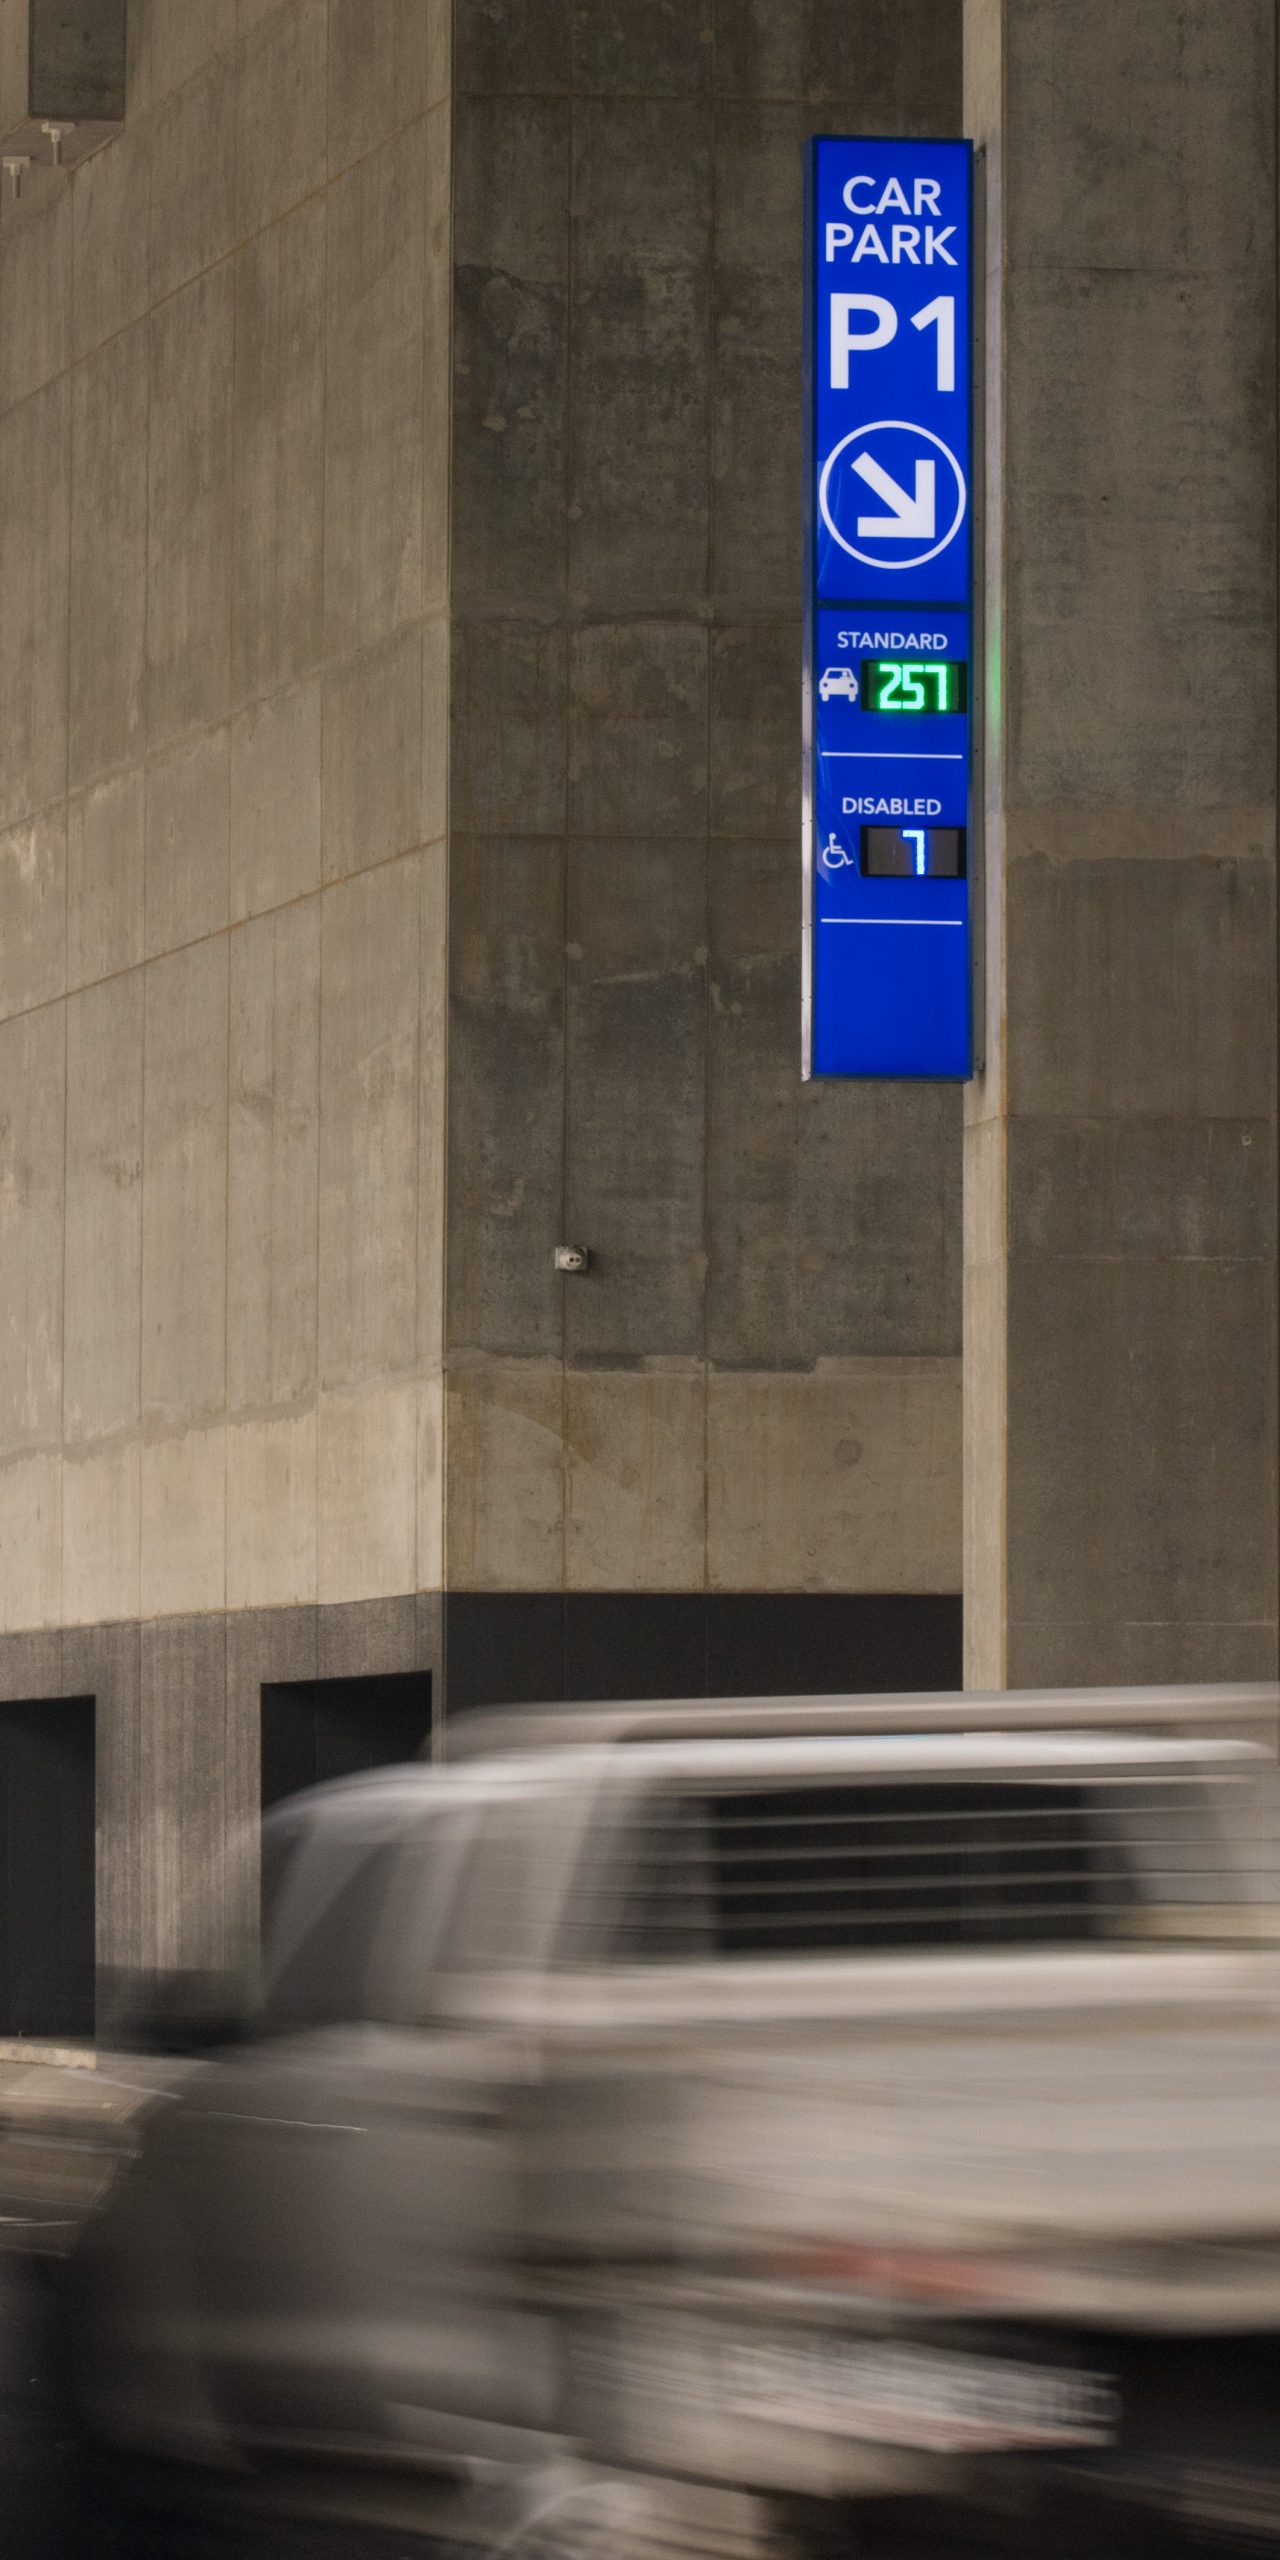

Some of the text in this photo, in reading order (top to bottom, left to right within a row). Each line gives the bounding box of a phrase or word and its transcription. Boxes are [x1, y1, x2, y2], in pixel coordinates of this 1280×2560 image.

[843, 175, 942, 216] CAR
[825, 223, 958, 266] PARK
[830, 292, 955, 392] P1
[837, 631, 948, 650] STANDARD
[878, 663, 948, 711] 257
[842, 797, 942, 816] DISABLED
[901, 829, 926, 876] 7
